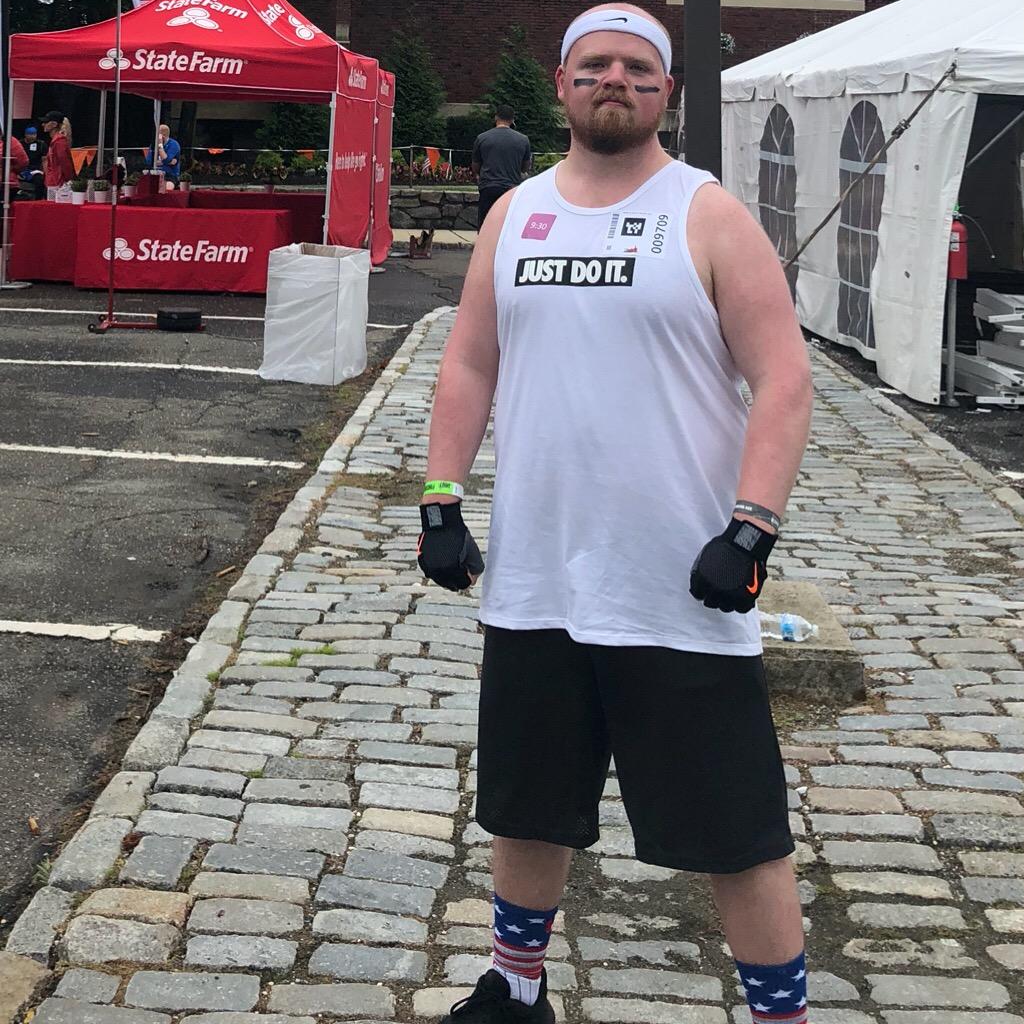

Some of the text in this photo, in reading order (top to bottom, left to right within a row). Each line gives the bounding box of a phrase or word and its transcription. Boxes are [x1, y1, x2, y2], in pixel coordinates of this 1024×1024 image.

[529, 220, 548, 231] 9:30
[650, 214, 669, 254] 009709
[518, 259, 628, 284] JUST DO IT.
